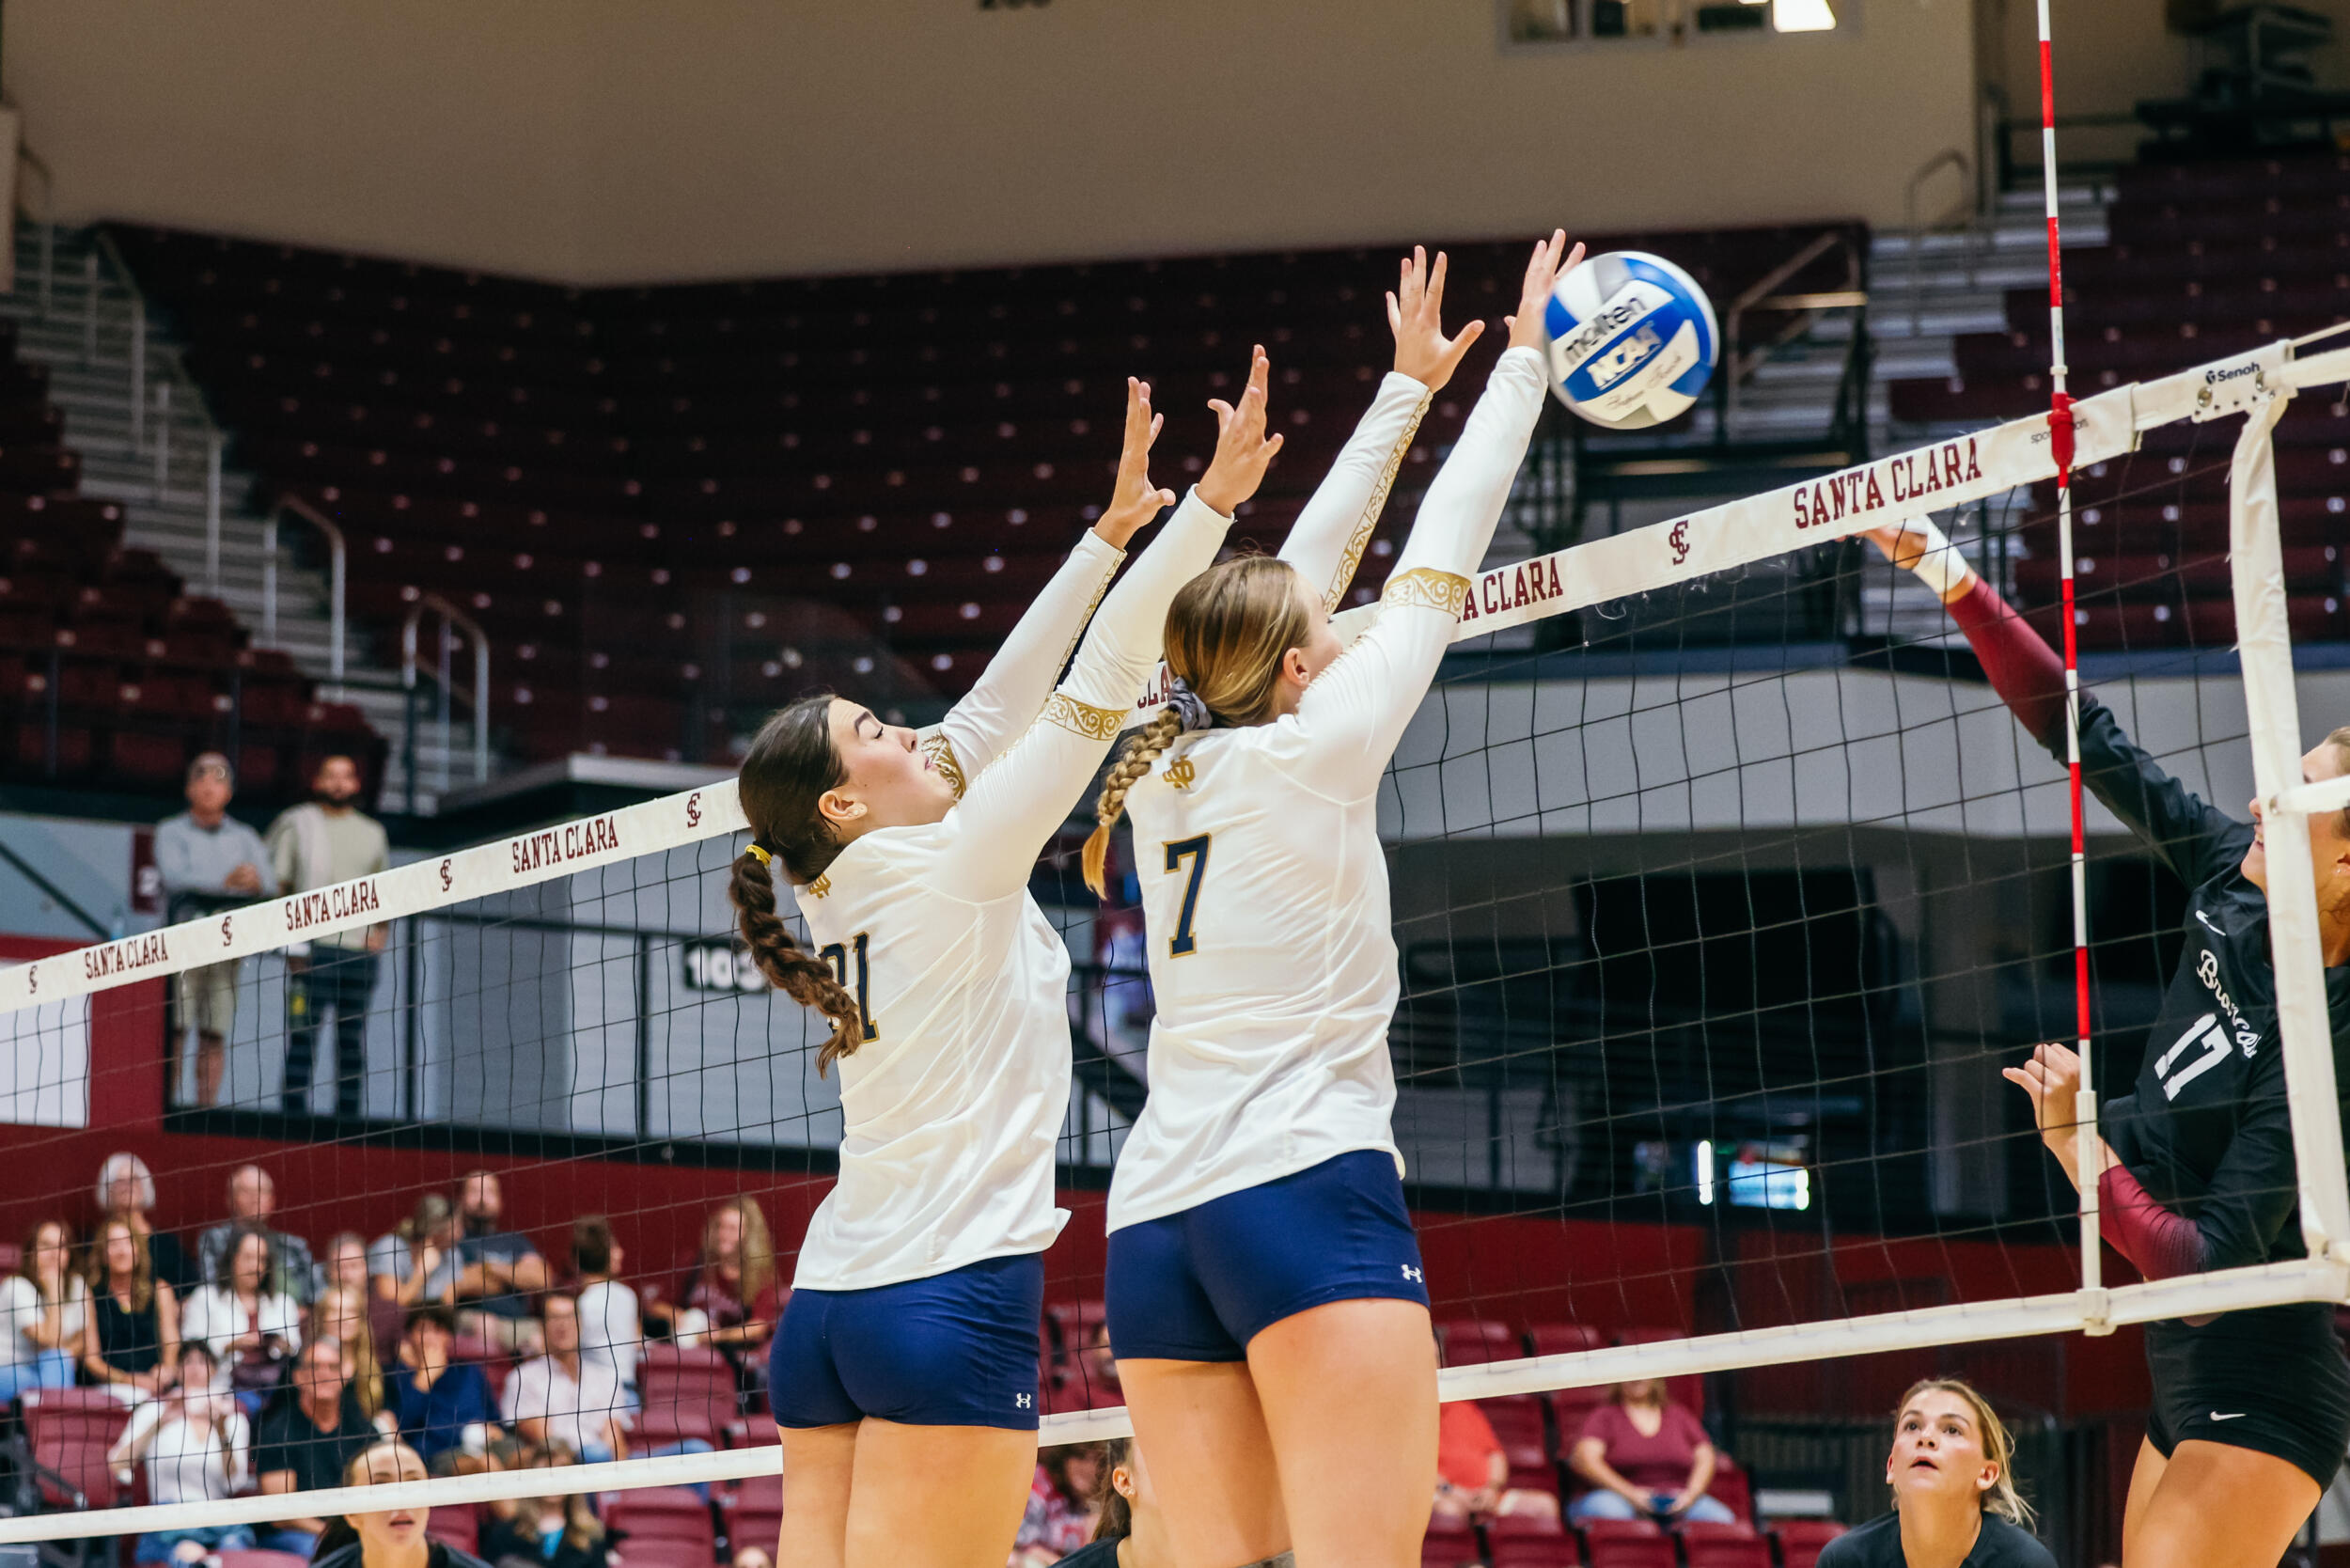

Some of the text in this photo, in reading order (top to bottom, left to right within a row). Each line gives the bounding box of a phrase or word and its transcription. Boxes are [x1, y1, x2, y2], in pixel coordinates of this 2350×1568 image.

[1564, 297, 1647, 366] molten
[2217, 362, 2261, 383] Senoh
[1794, 437, 1982, 529] SANTA CLARA
[1482, 557, 1564, 615] CLARA
[512, 815, 619, 873] SANTA CLARA
[285, 878, 380, 932] SANTA CLARA
[1162, 832, 1213, 960] 7
[85, 933, 169, 980] SANTA CLARA
[2154, 1012, 2233, 1102] 17
